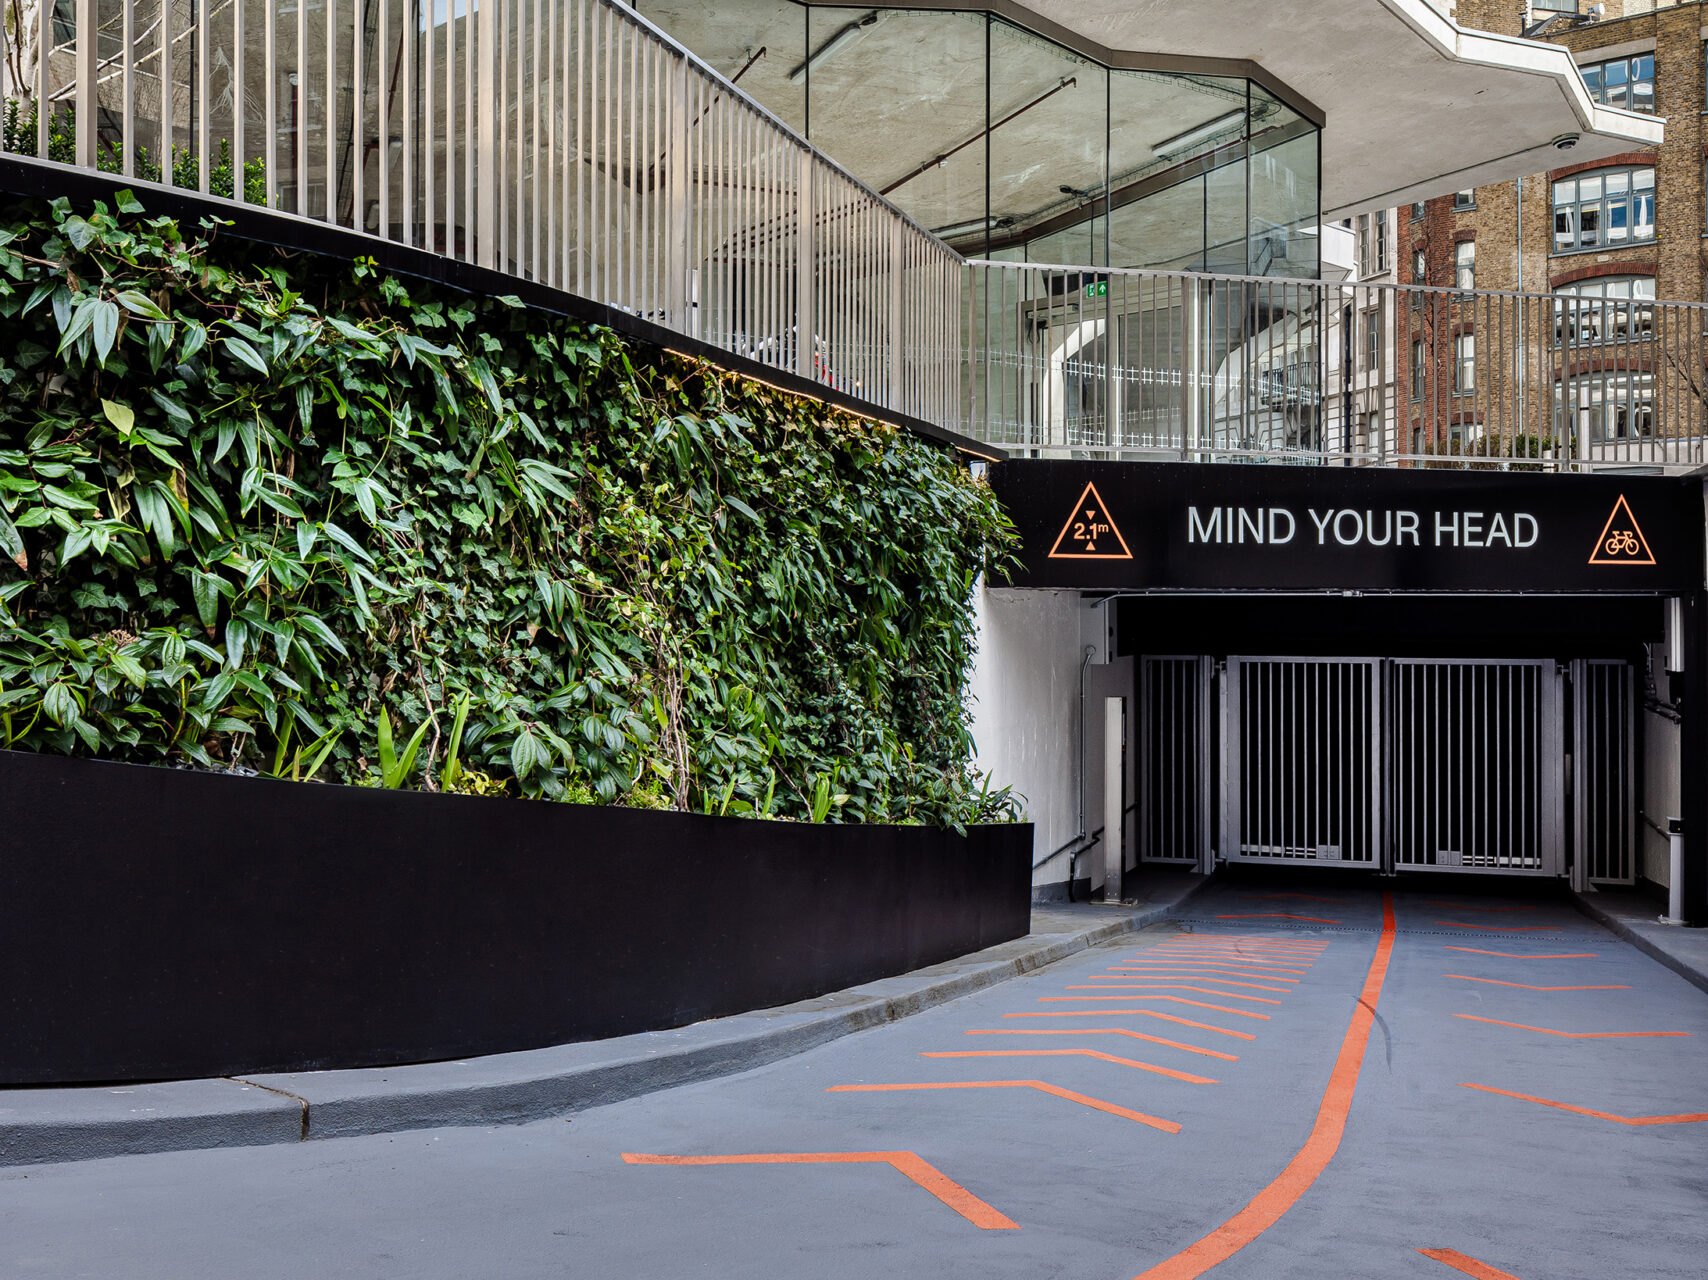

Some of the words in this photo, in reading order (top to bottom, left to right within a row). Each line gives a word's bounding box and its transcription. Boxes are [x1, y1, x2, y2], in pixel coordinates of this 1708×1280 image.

[1073, 522, 1109, 540] 2.1m
[1187, 506, 1296, 545] MIND
[1307, 508, 1420, 546] YOUR
[1434, 511, 1540, 548] HEAD
